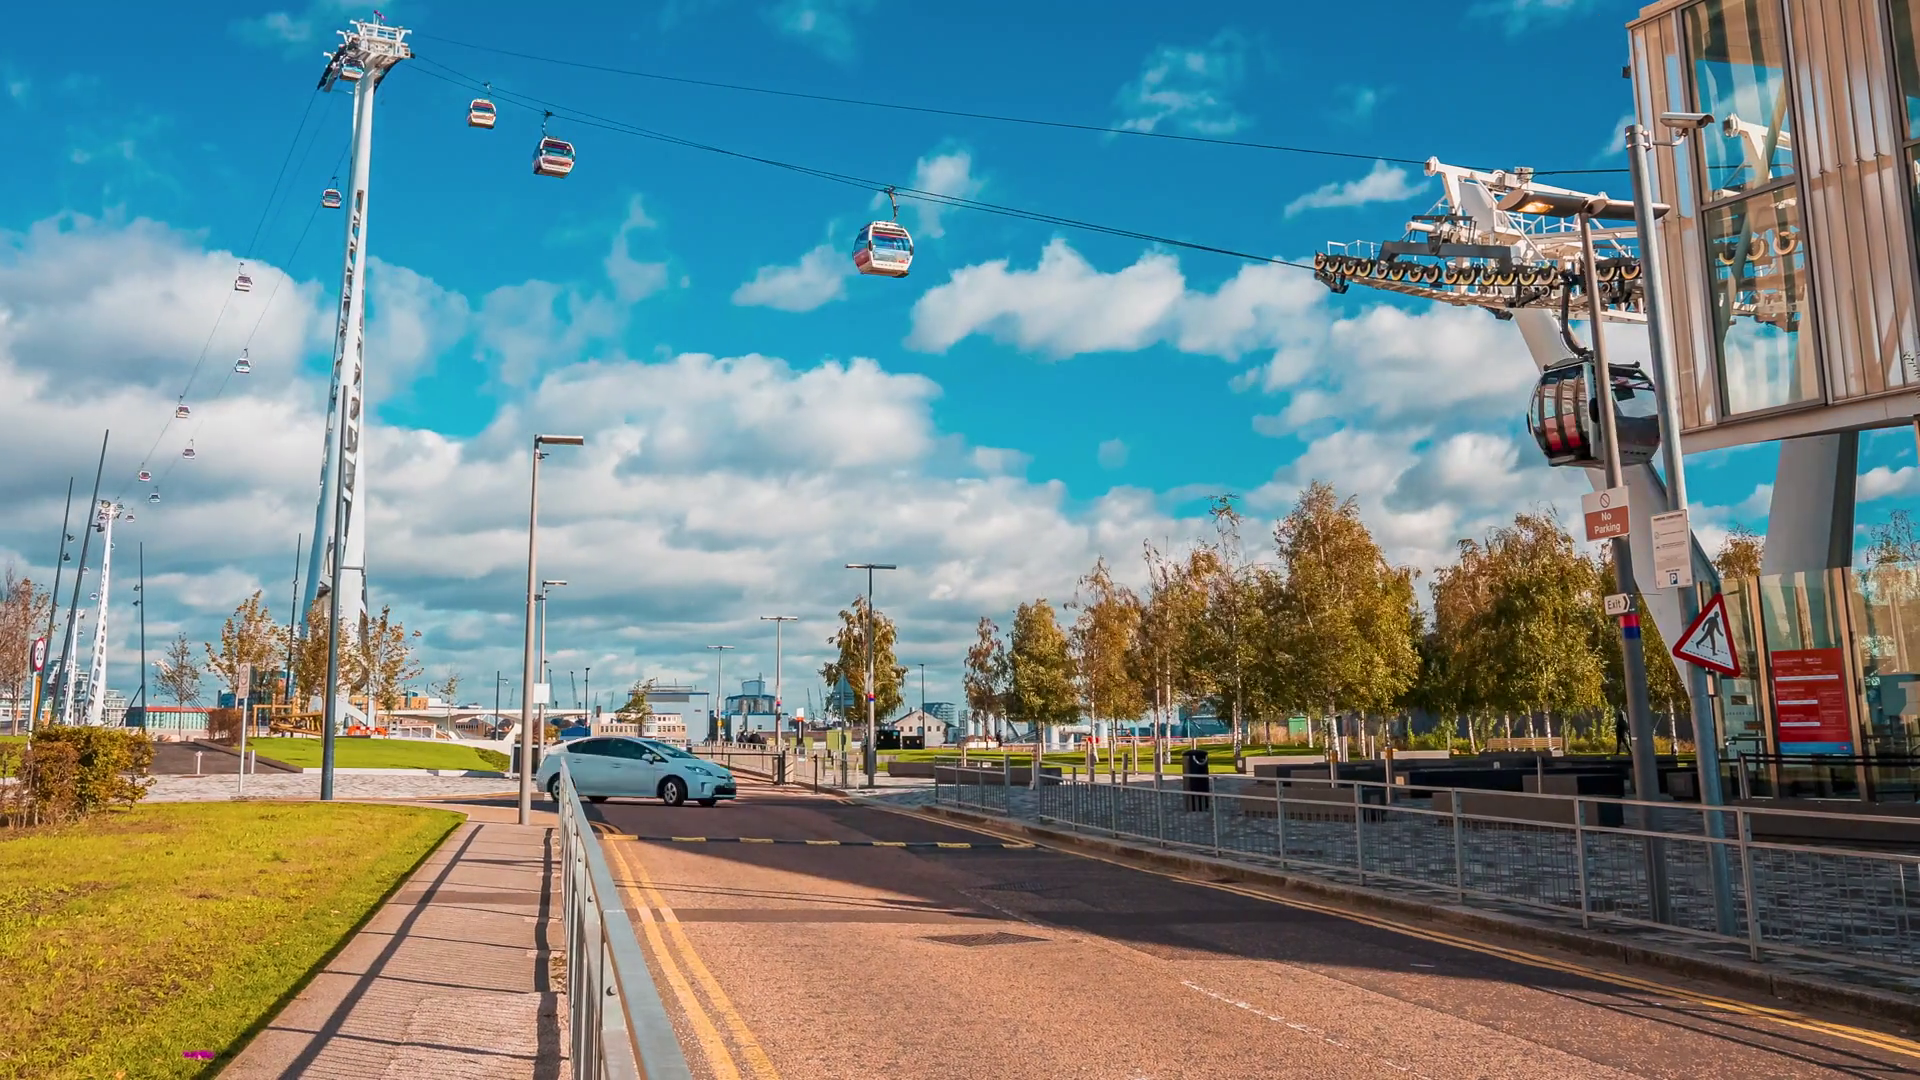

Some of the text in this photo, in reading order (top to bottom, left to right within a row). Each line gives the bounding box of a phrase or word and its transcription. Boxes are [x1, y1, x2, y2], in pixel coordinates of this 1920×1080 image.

[1601, 511, 1612, 521] No
[1594, 522, 1621, 535] Parking
[1607, 599, 1621, 610] Exit
[36, 647, 43, 660] 20
